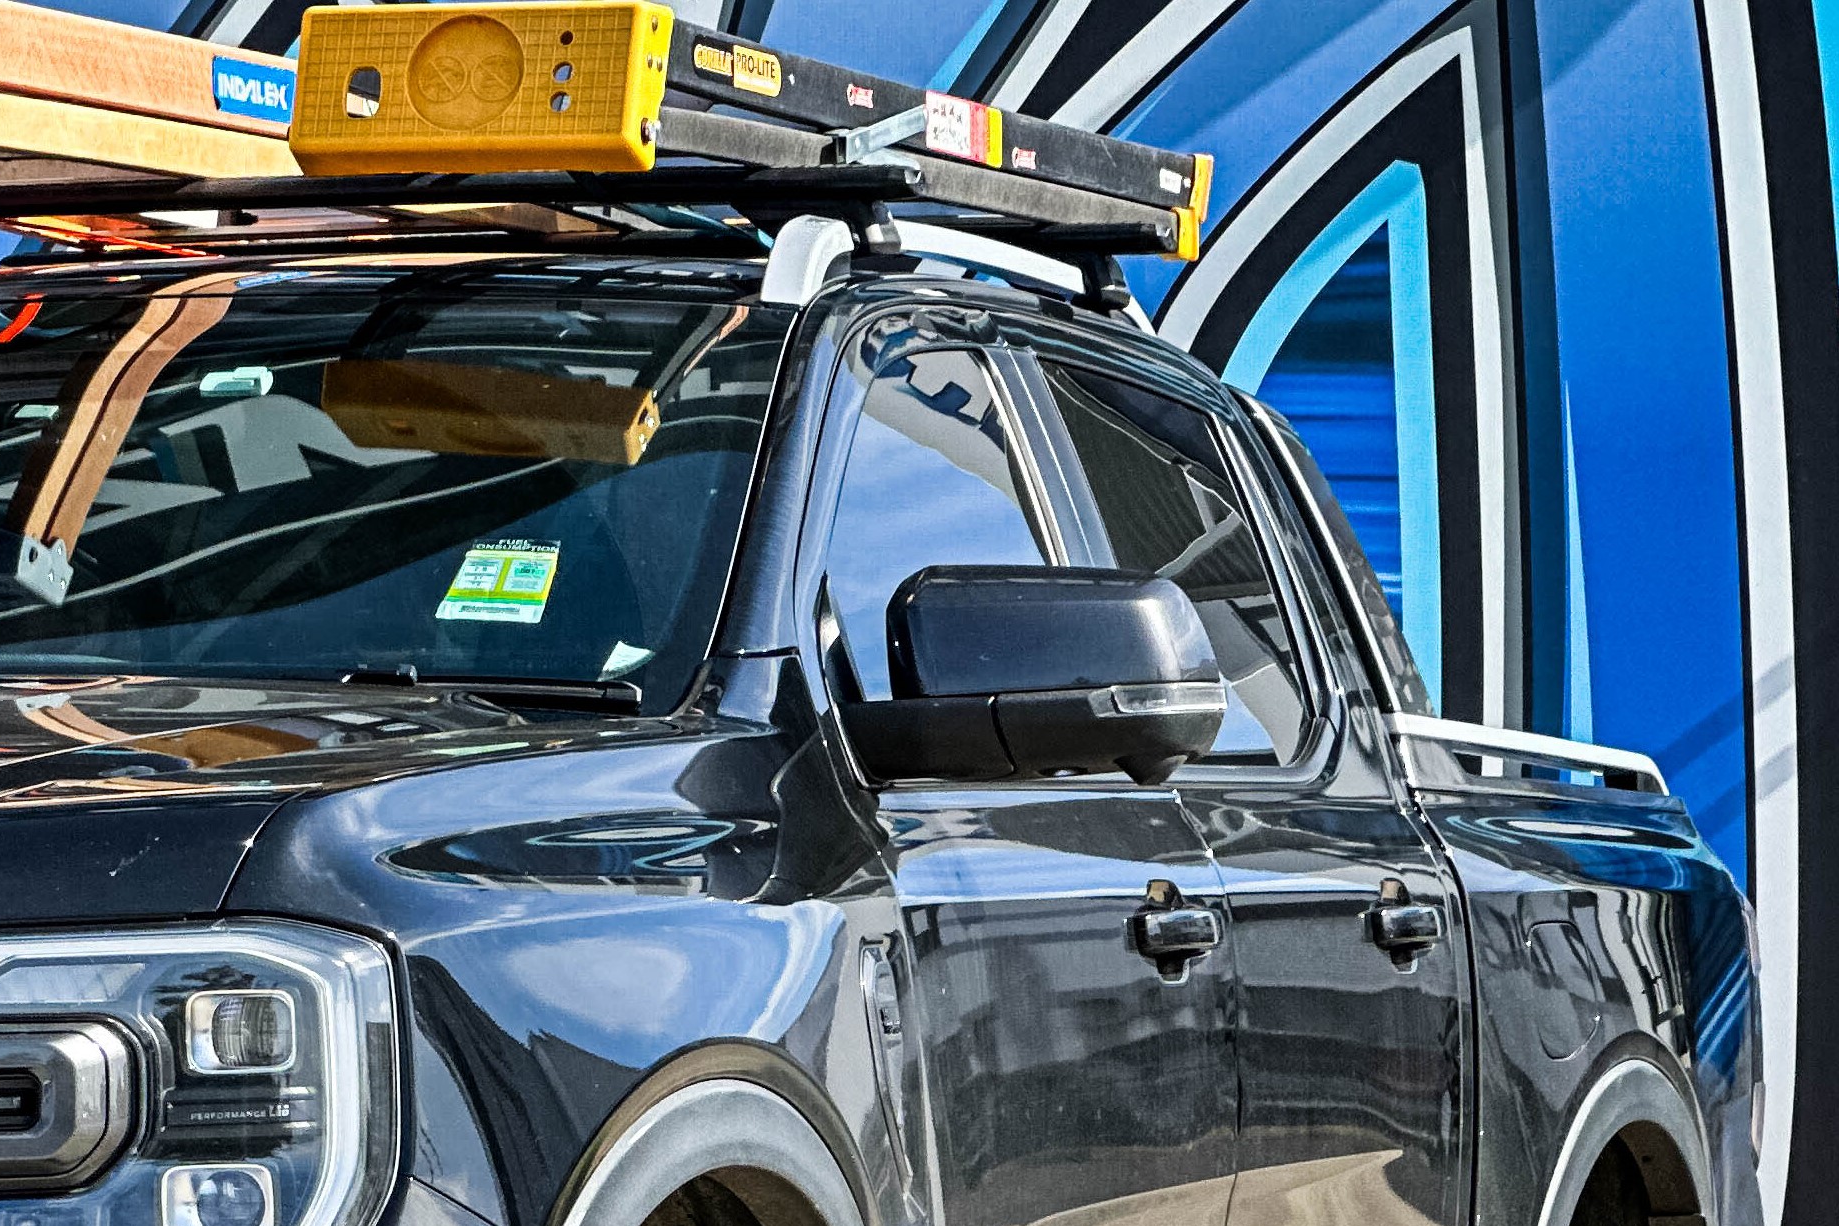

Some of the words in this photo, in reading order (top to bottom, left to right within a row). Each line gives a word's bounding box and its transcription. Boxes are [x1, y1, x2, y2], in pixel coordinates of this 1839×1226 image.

[736, 52, 776, 78] PRO-LITE
[218, 73, 288, 109] INDALEX
[473, 543, 560, 553] ONSUMPTION
[190, 1110, 266, 1121] PERFORMANCE
[268, 1104, 290, 1117] LED
